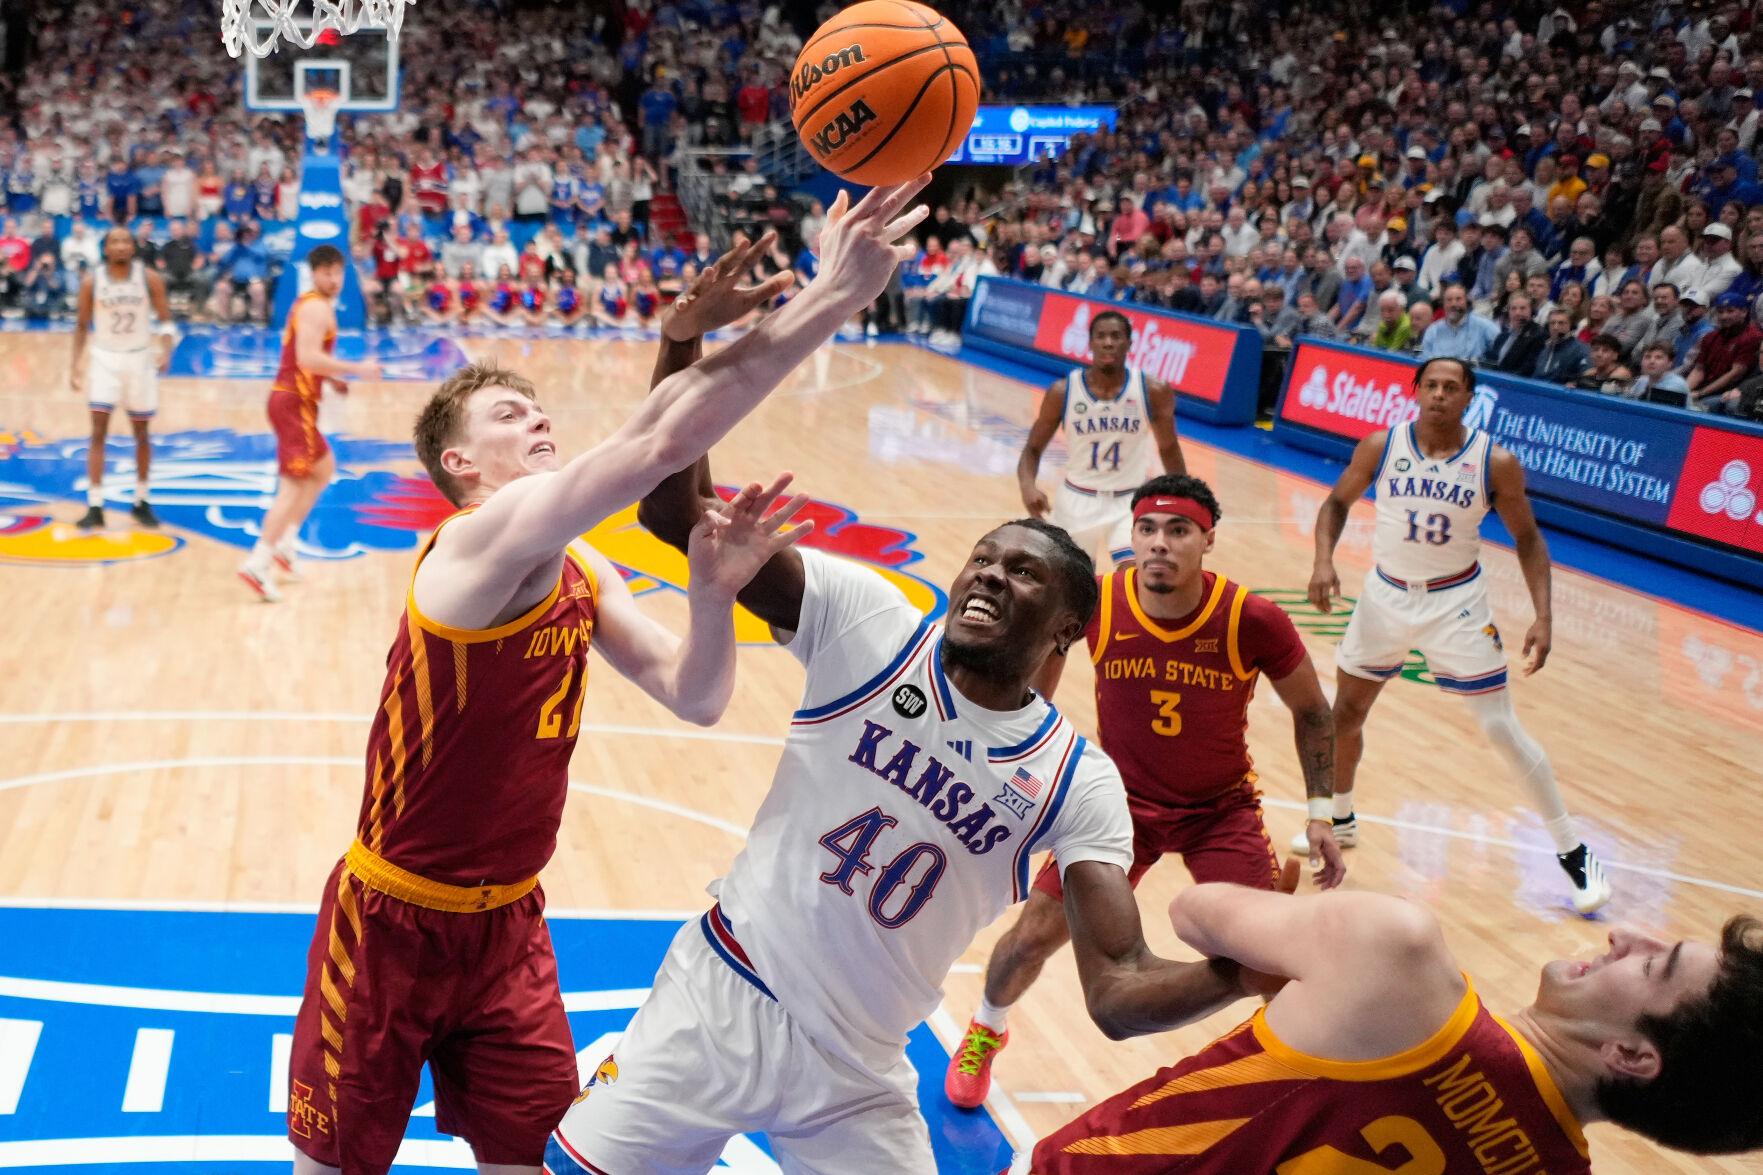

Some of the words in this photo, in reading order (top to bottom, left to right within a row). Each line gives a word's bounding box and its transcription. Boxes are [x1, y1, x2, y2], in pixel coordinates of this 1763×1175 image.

[810, 99, 877, 158] NCAA
[111, 311, 136, 334] 22
[1326, 370, 1421, 429] StateFar
[1073, 417, 1140, 435] KANSAS
[1496, 408, 1526, 438] THE
[1527, 415, 1622, 461] UNIVERSITY
[1620, 440, 1647, 467] OF
[1088, 440, 1122, 471] 14
[1543, 447, 1607, 488] HEALTH
[1606, 463, 1670, 504] SYSTEM
[1389, 477, 1475, 509] KANSAS
[1404, 509, 1451, 546] 13
[1104, 657, 1156, 680] IOWA
[1165, 660, 1233, 691] STATE
[535, 663, 589, 740] 21
[895, 687, 925, 715] SW
[1150, 690, 1182, 737] 3
[848, 719, 1012, 855] KANSAS
[818, 806, 947, 930] 40
[290, 1094, 329, 1134] TATE
[1422, 1053, 1547, 1175] MOMCIL
